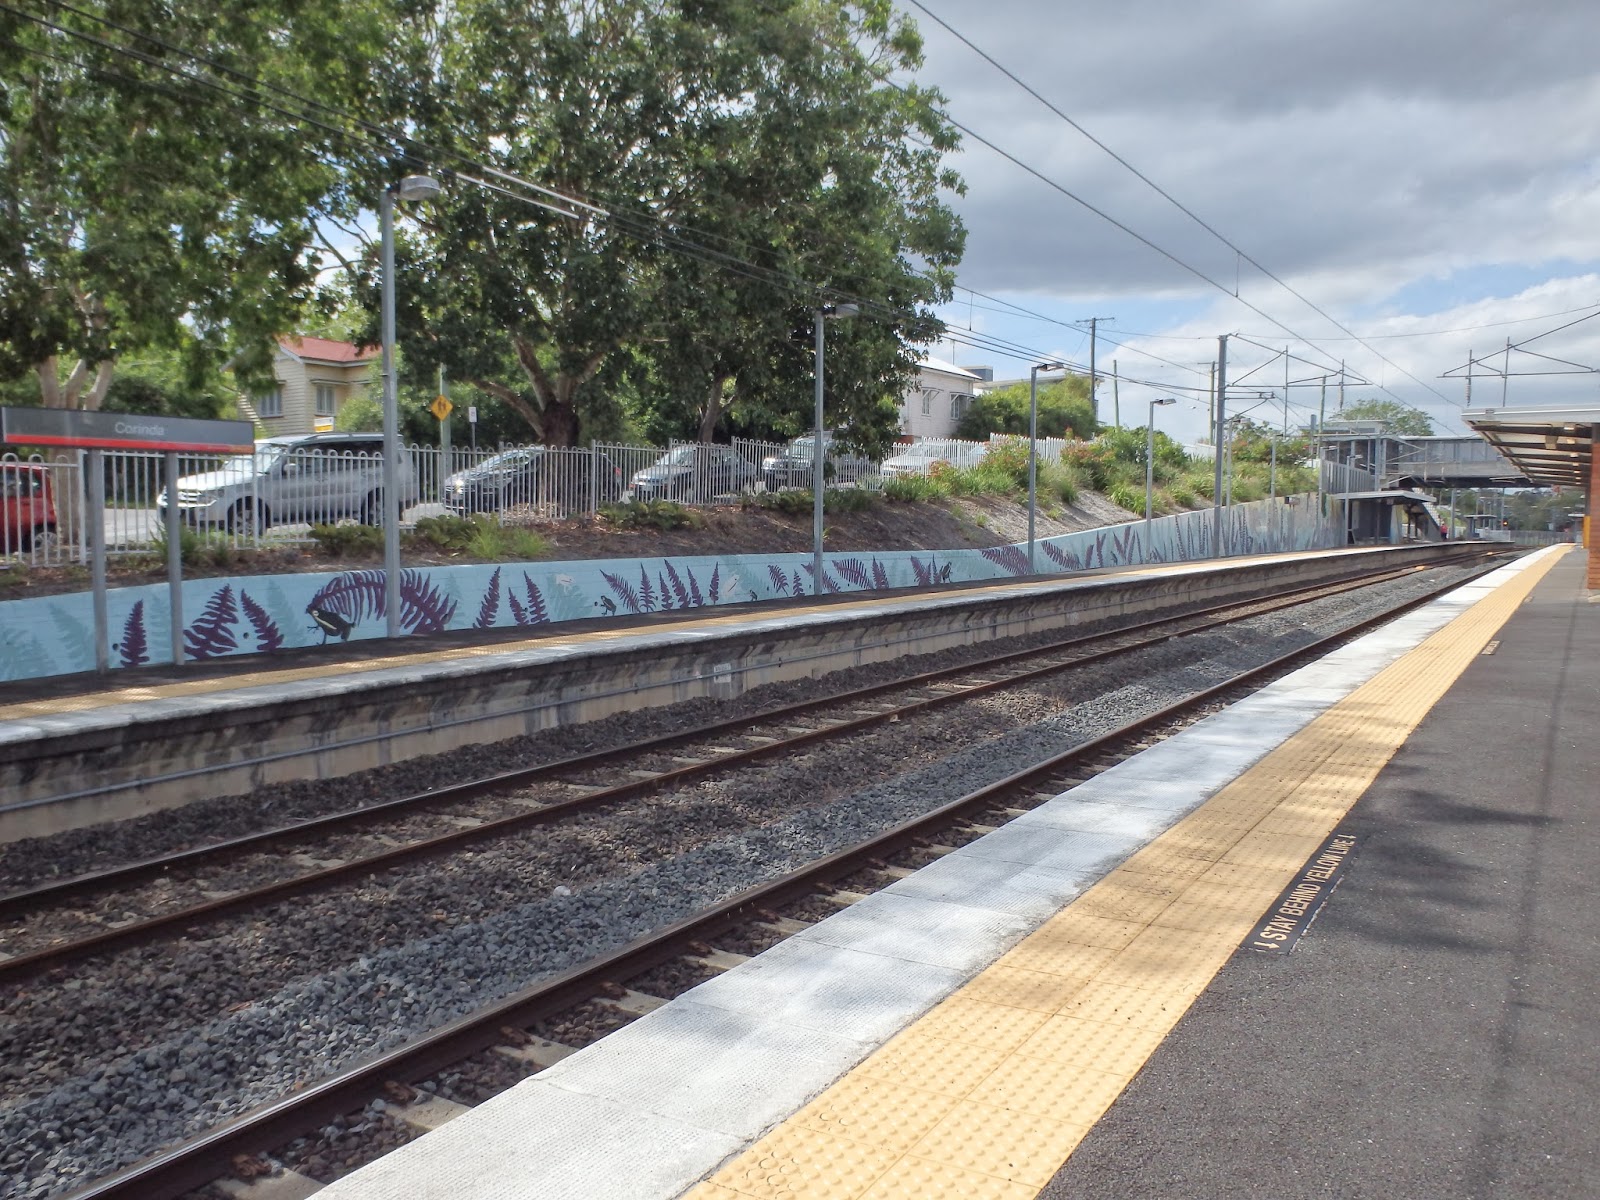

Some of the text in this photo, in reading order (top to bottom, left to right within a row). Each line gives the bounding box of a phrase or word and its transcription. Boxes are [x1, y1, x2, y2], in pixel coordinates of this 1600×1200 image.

[114, 422, 165, 437] Corinda
[1260, 839, 1355, 941] STAY BEHIND YELLOW LINE
